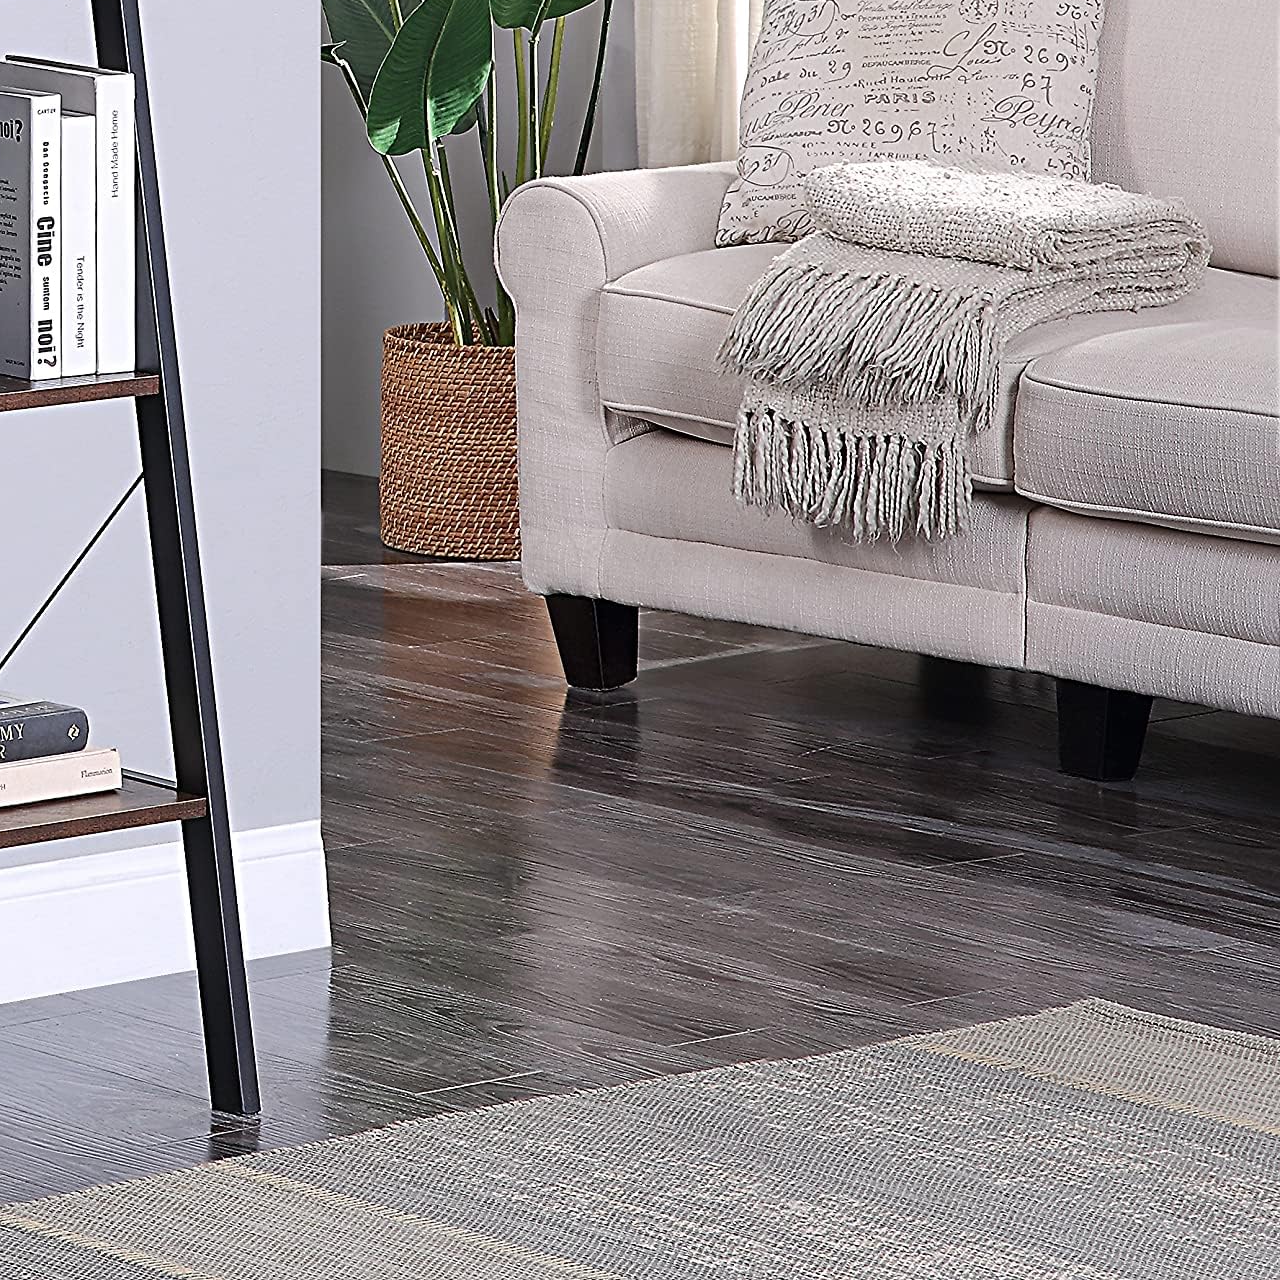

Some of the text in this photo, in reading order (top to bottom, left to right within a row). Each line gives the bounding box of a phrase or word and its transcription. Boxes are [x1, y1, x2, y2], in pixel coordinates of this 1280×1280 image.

[864, 90, 936, 105] PARIS
[110, 109, 119, 198] Hand Made Home
[36, 215, 56, 267] Cine
[75, 256, 85, 349] Tender is the Night
[37, 318, 57, 367] noi?
